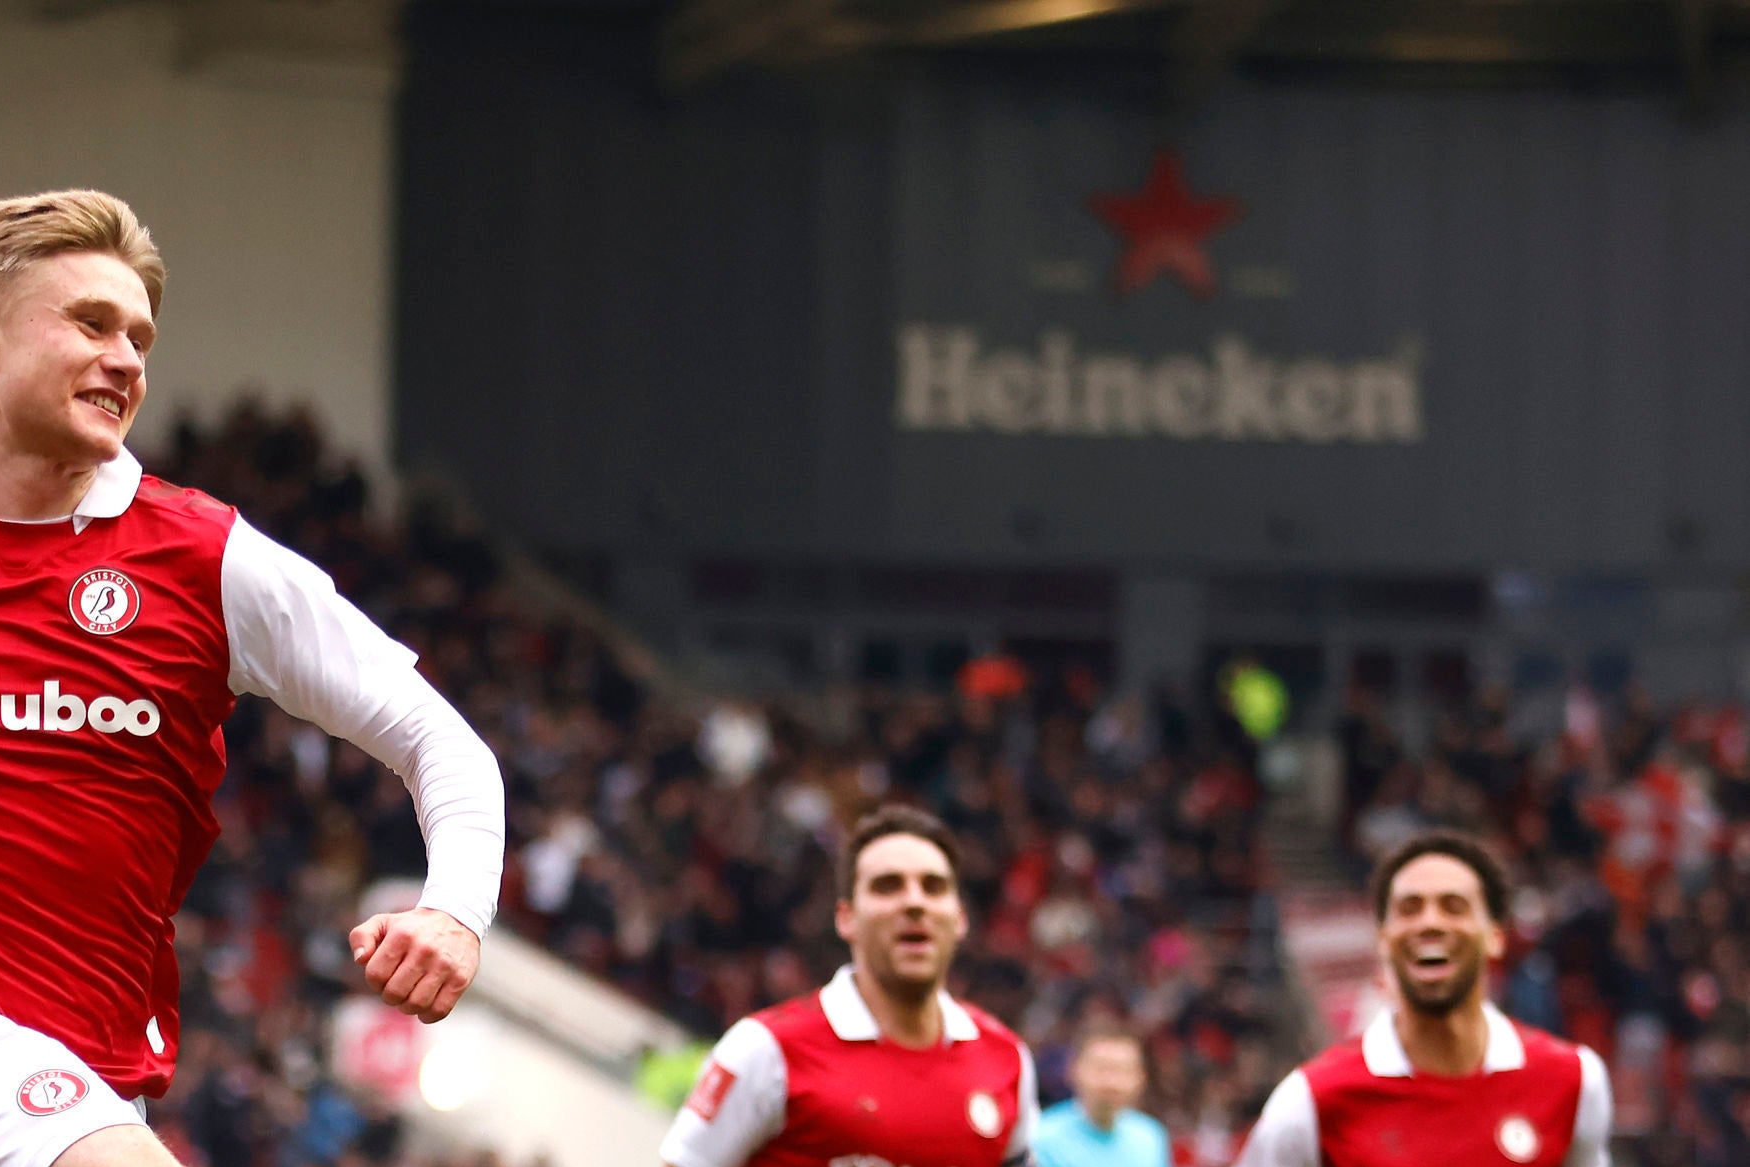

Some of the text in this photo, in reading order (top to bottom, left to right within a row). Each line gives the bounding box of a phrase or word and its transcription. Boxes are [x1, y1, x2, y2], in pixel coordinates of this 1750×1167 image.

[900, 324, 1423, 444] Heineken
[83, 572, 128, 590] BRISTOL
[89, 622, 117, 632] CITY
